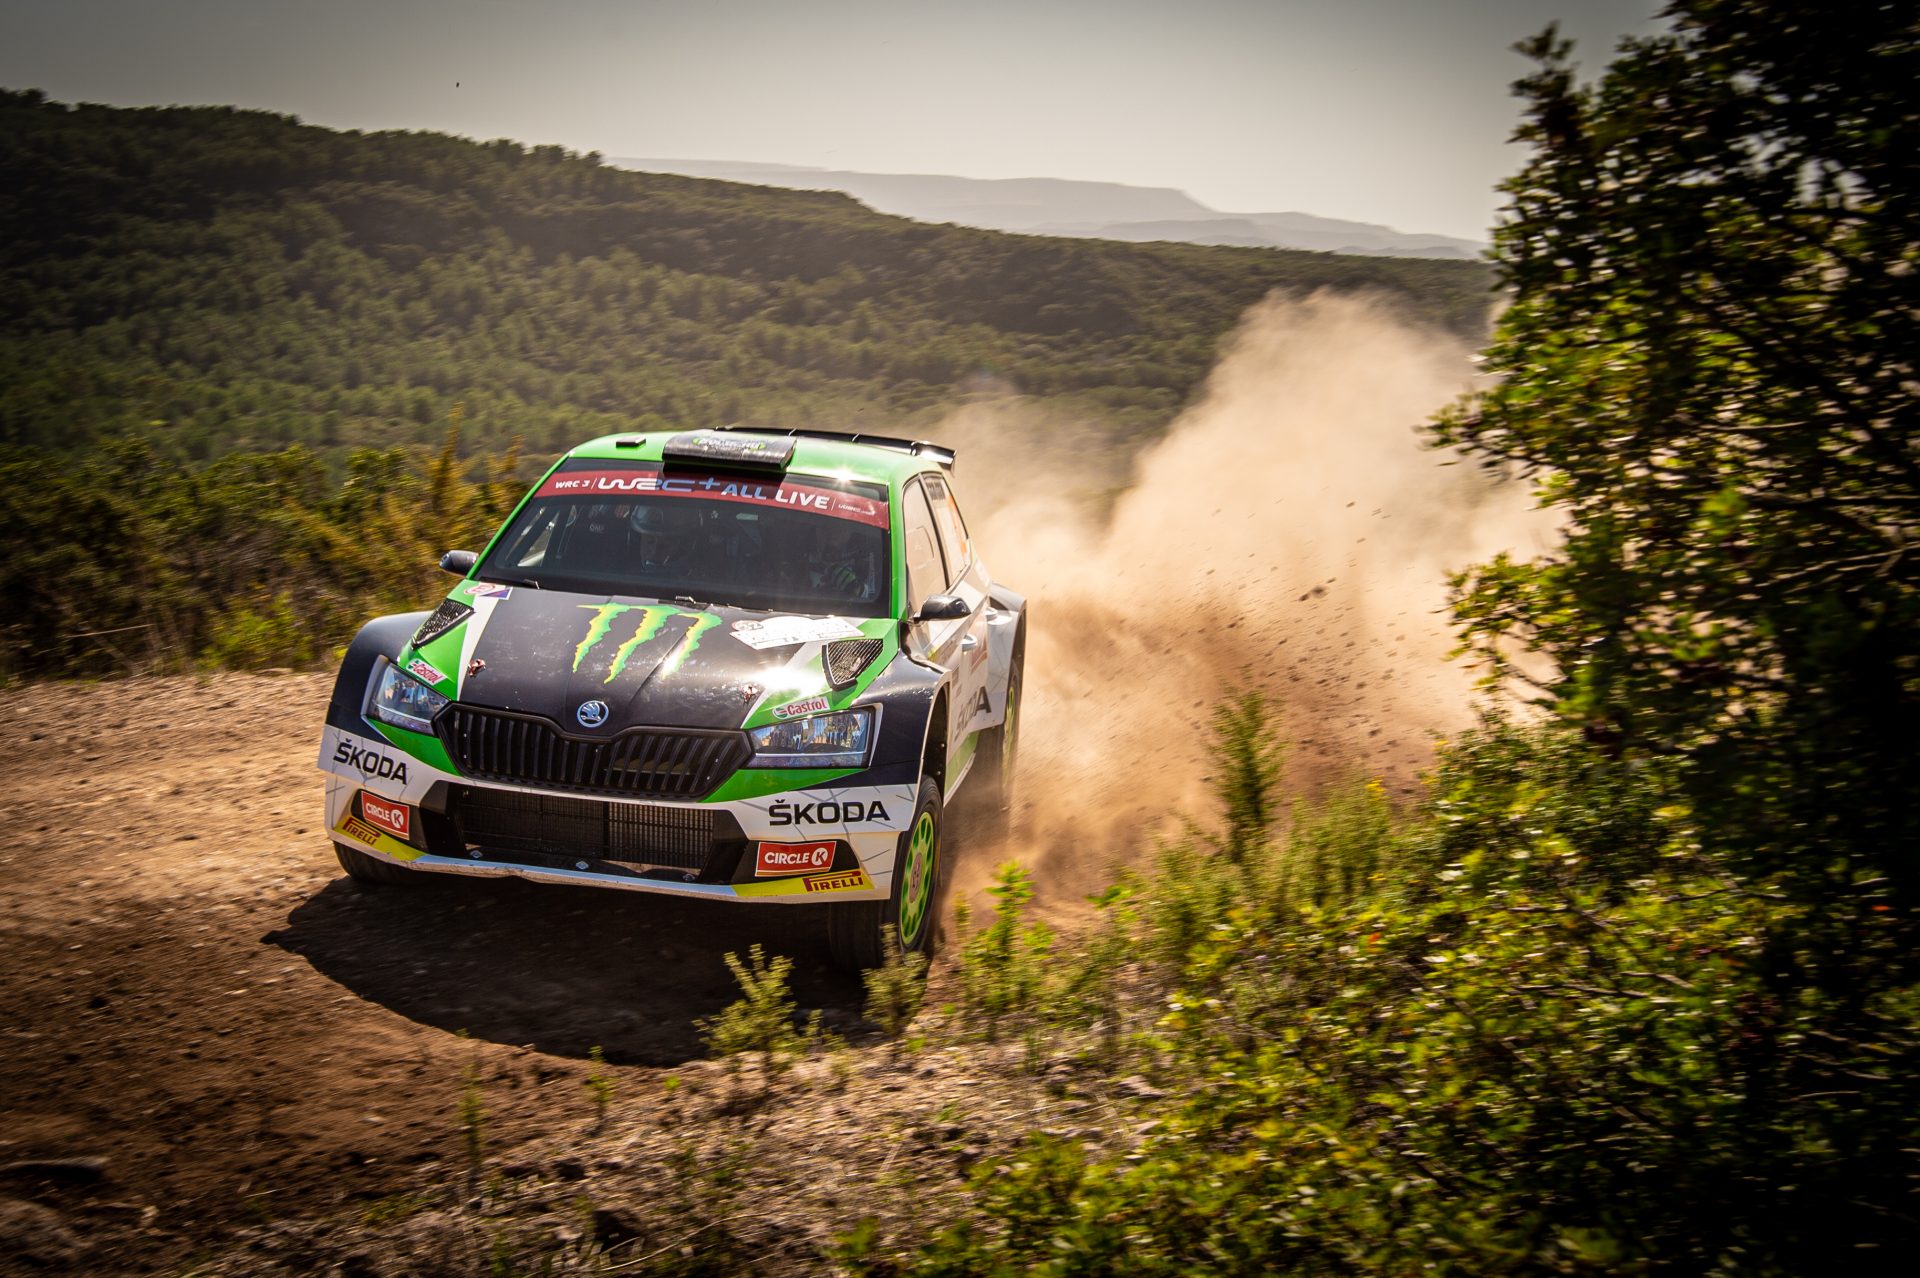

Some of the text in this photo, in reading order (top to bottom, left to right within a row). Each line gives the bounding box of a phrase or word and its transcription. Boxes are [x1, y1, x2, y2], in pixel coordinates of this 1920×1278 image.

[555, 480, 579, 489] WRC
[582, 480, 590, 488] 3
[721, 483, 767, 500] ALL
[775, 489, 830, 510] LIVE
[787, 698, 828, 716] Castrol
[333, 738, 408, 785] ŠKODA
[365, 802, 404, 829] CIRCLE K
[768, 799, 891, 826] ŠKODA
[342, 816, 381, 846] PIRELLI
[764, 847, 829, 866] CIRCLE K
[802, 870, 864, 892] PIRELLI
